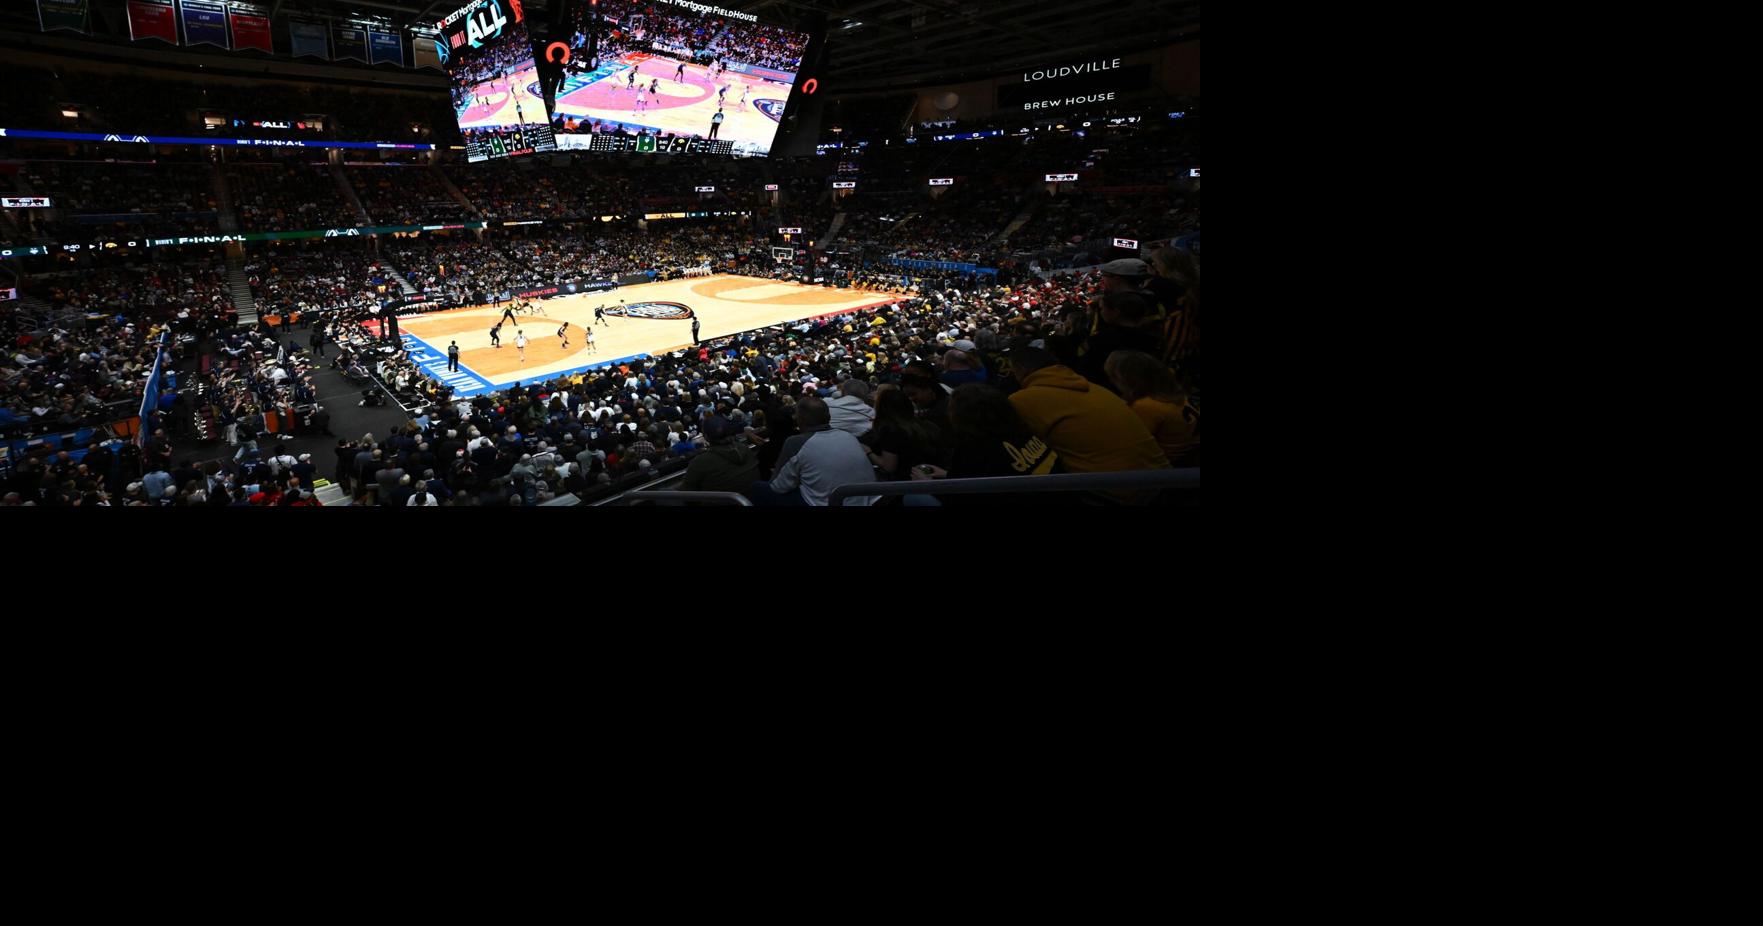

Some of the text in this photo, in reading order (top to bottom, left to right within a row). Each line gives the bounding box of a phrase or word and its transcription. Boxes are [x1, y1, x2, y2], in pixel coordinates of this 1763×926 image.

[436, 0, 482, 30] ROCKET Mortgag
[674, 0, 712, 14] Mortgage
[468, 4, 507, 46] ALL
[1024, 58, 1120, 82] LOUDVILLE
[1024, 92, 1115, 110] BREW HOUSE
[519, 287, 558, 298] HUSKIES
[1002, 435, 1048, 473] Iowa
